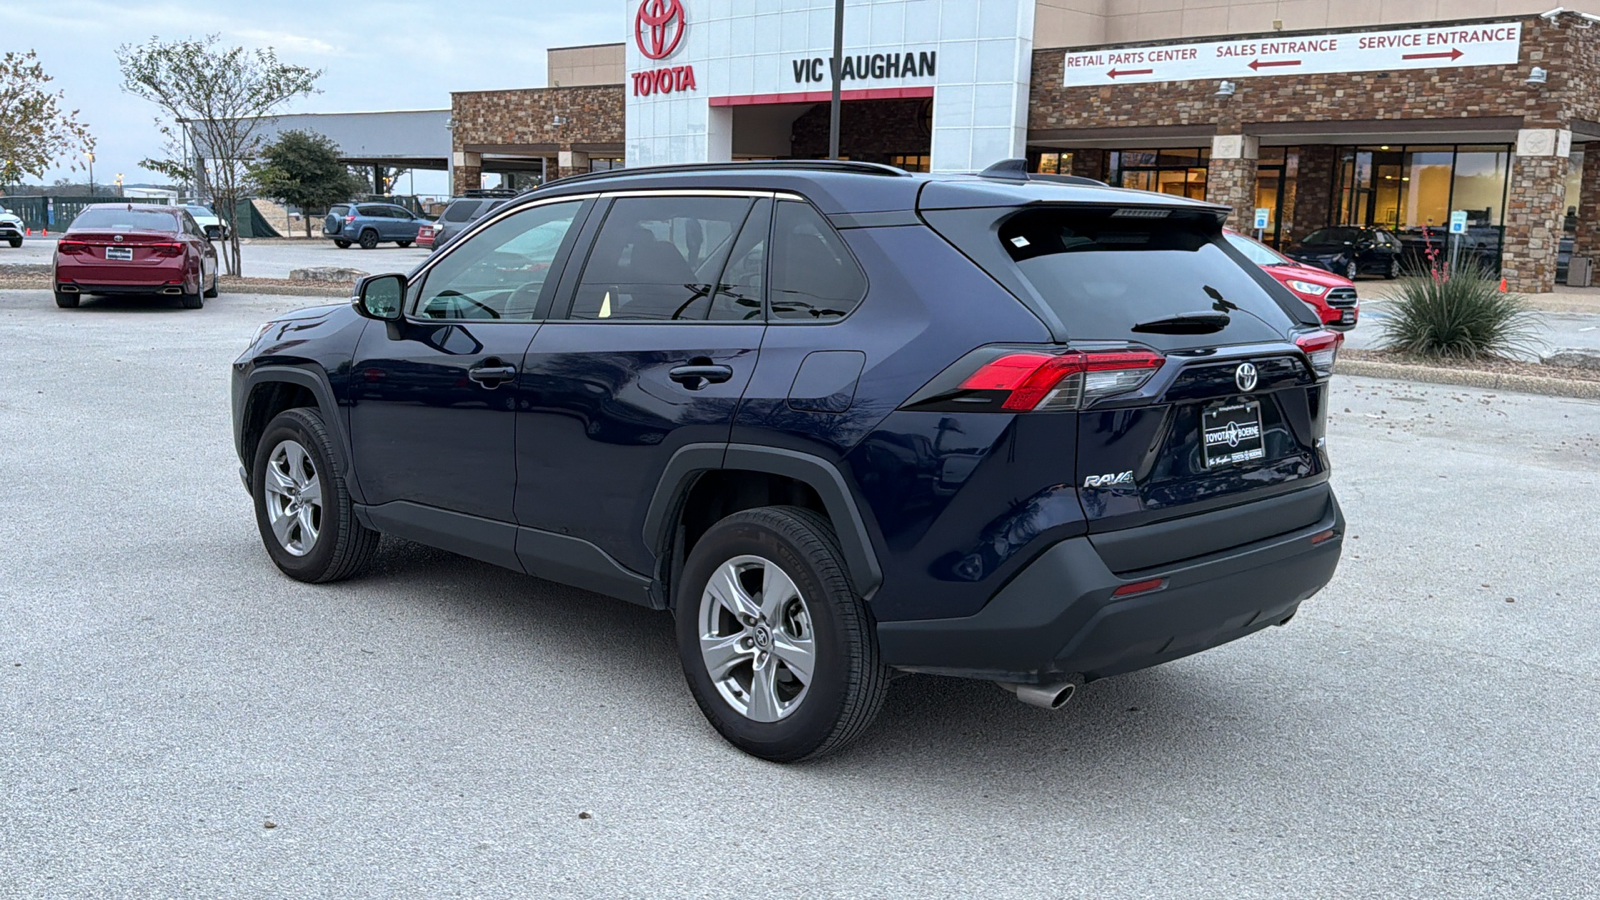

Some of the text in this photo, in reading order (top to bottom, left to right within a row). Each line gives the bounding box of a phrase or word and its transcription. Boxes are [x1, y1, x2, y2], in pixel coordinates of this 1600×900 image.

[1358, 27, 1516, 49] SERVICE ENTRANCE
[1067, 48, 1197, 67] RETAIL PARTS CENTER
[1216, 39, 1337, 57] SALES ENTRANCE
[793, 58, 824, 83] VIC
[631, 65, 696, 96] TOYOTA
[1205, 426, 1259, 442] TOYOTA BOERNE
[1083, 470, 1133, 488] RAV4
